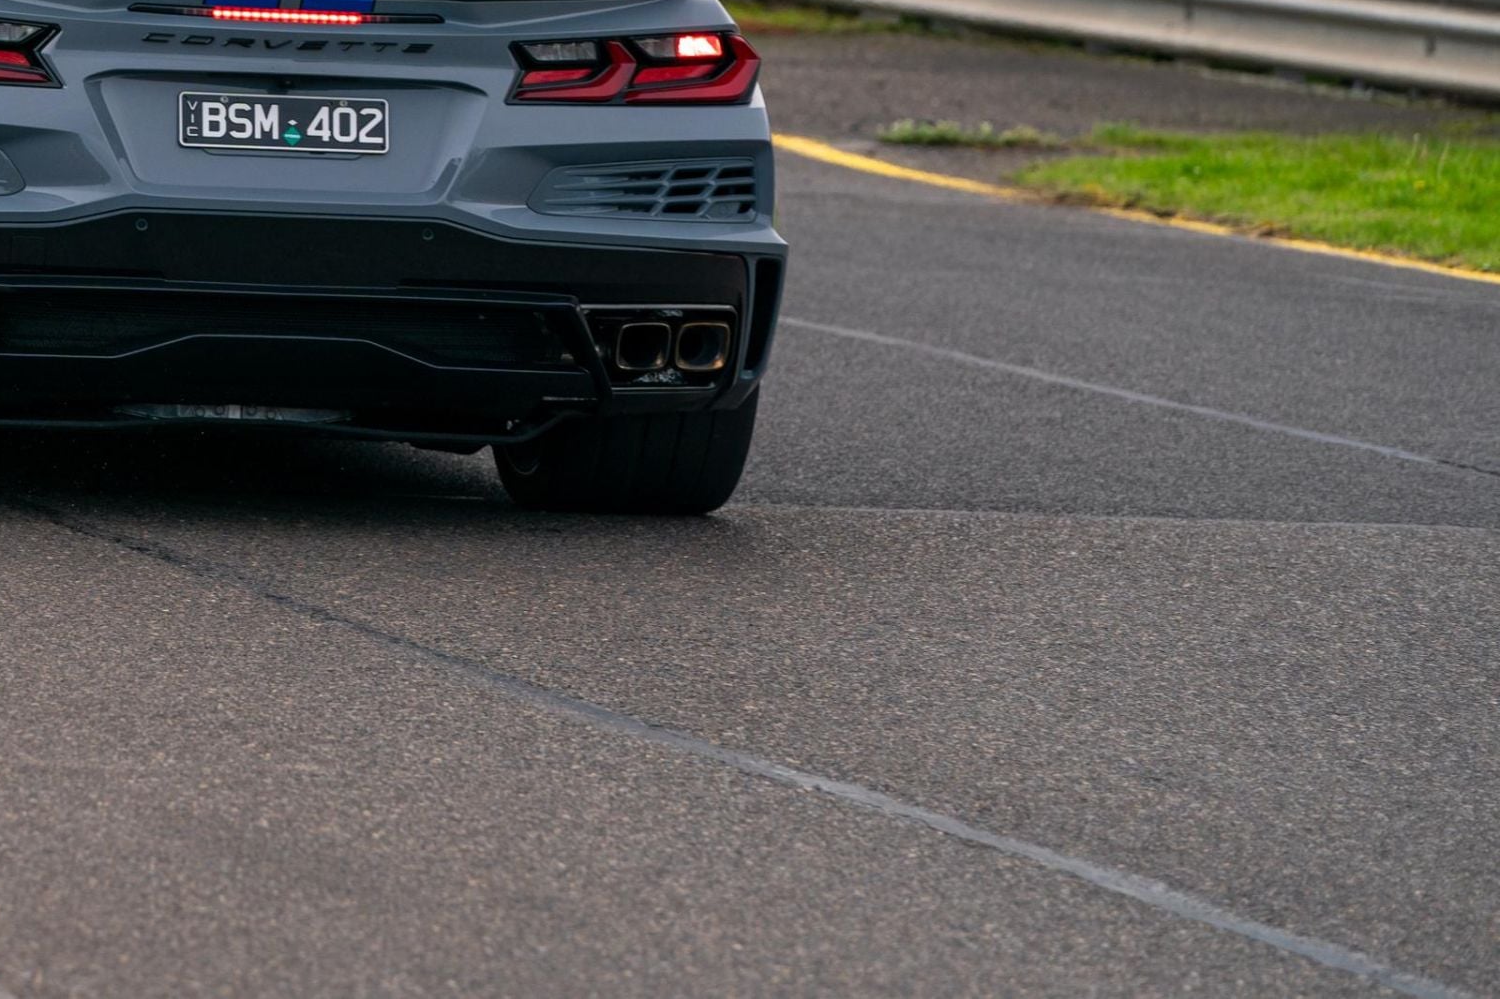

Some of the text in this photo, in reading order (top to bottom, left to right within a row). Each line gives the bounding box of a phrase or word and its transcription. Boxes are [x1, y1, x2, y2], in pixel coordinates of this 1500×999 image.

[141, 32, 435, 54] CORVETTE
[186, 100, 199, 137] VIC
[201, 101, 385, 144] BSM 402
